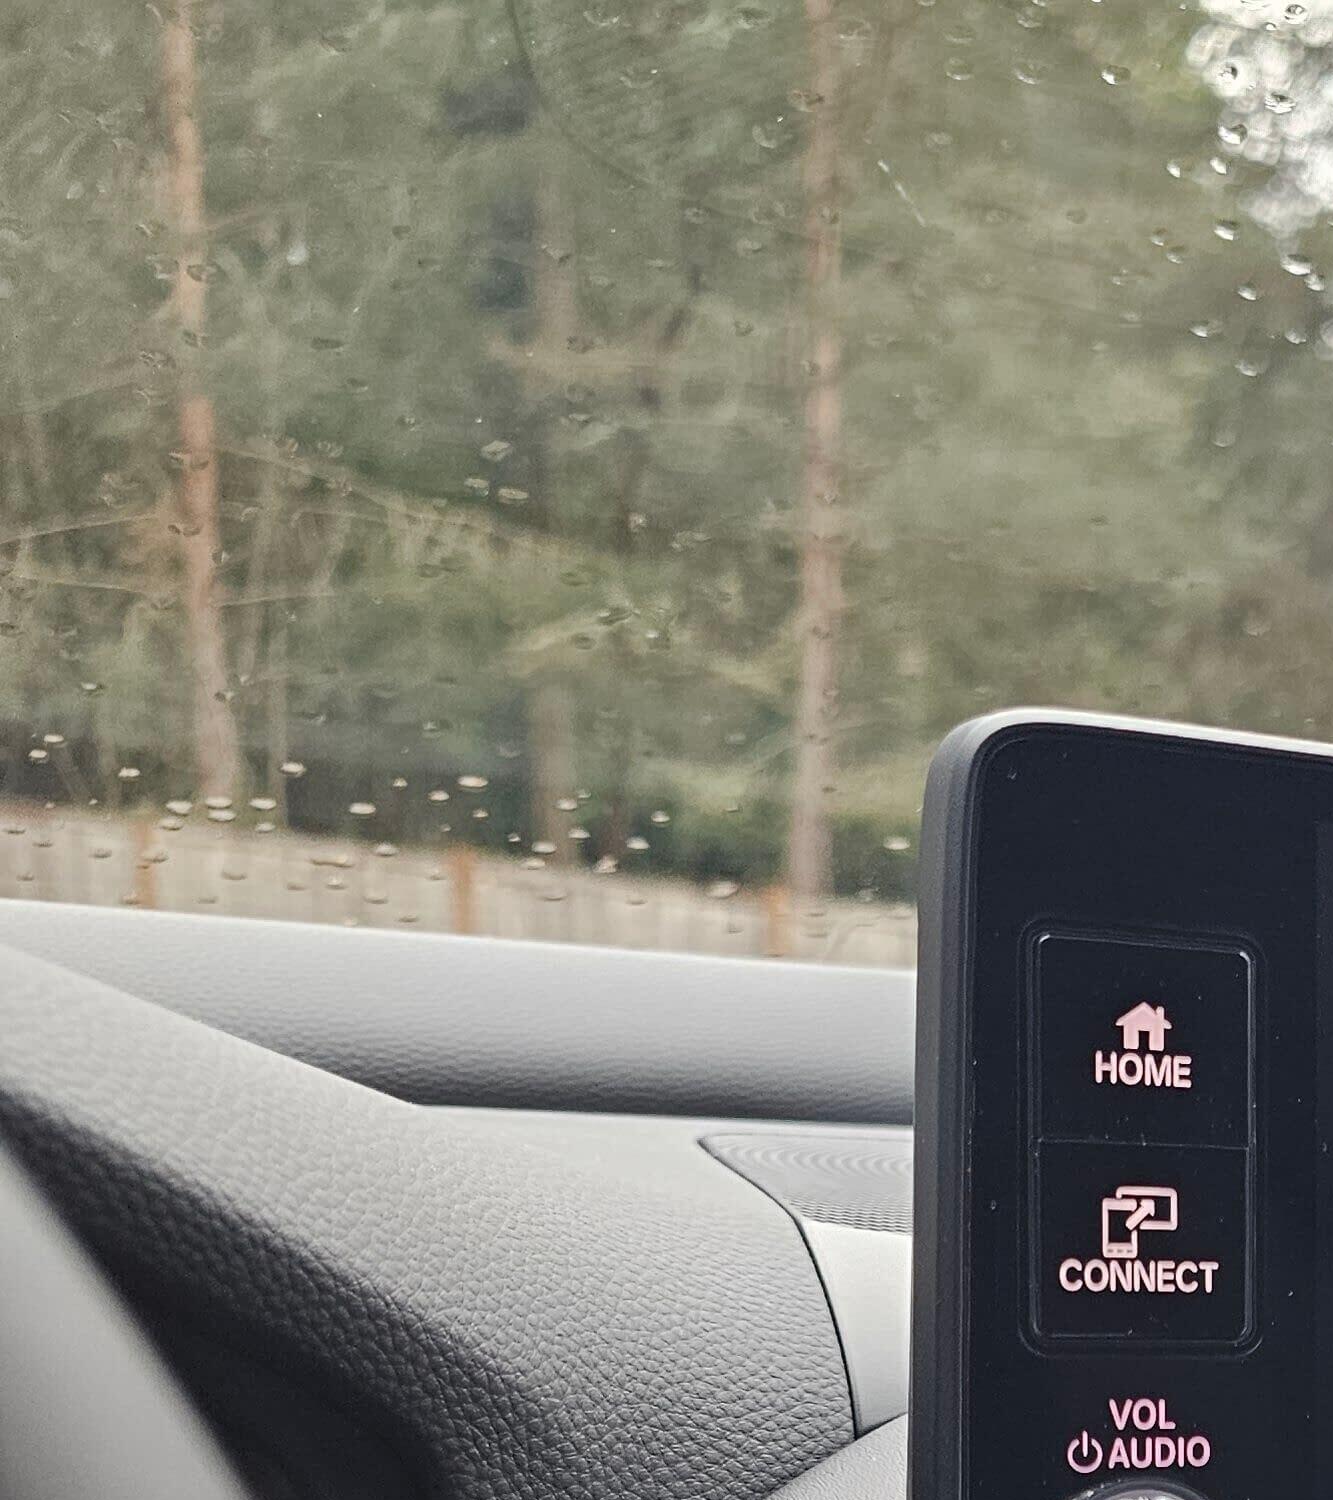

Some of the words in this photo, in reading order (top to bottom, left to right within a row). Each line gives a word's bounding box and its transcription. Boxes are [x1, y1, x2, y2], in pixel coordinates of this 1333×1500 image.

[1094, 1051, 1193, 1090] HOME
[1058, 1257, 1220, 1295] CONNECT
[1109, 1398, 1176, 1431] VOL
[1108, 1435, 1211, 1469] AUDIO
